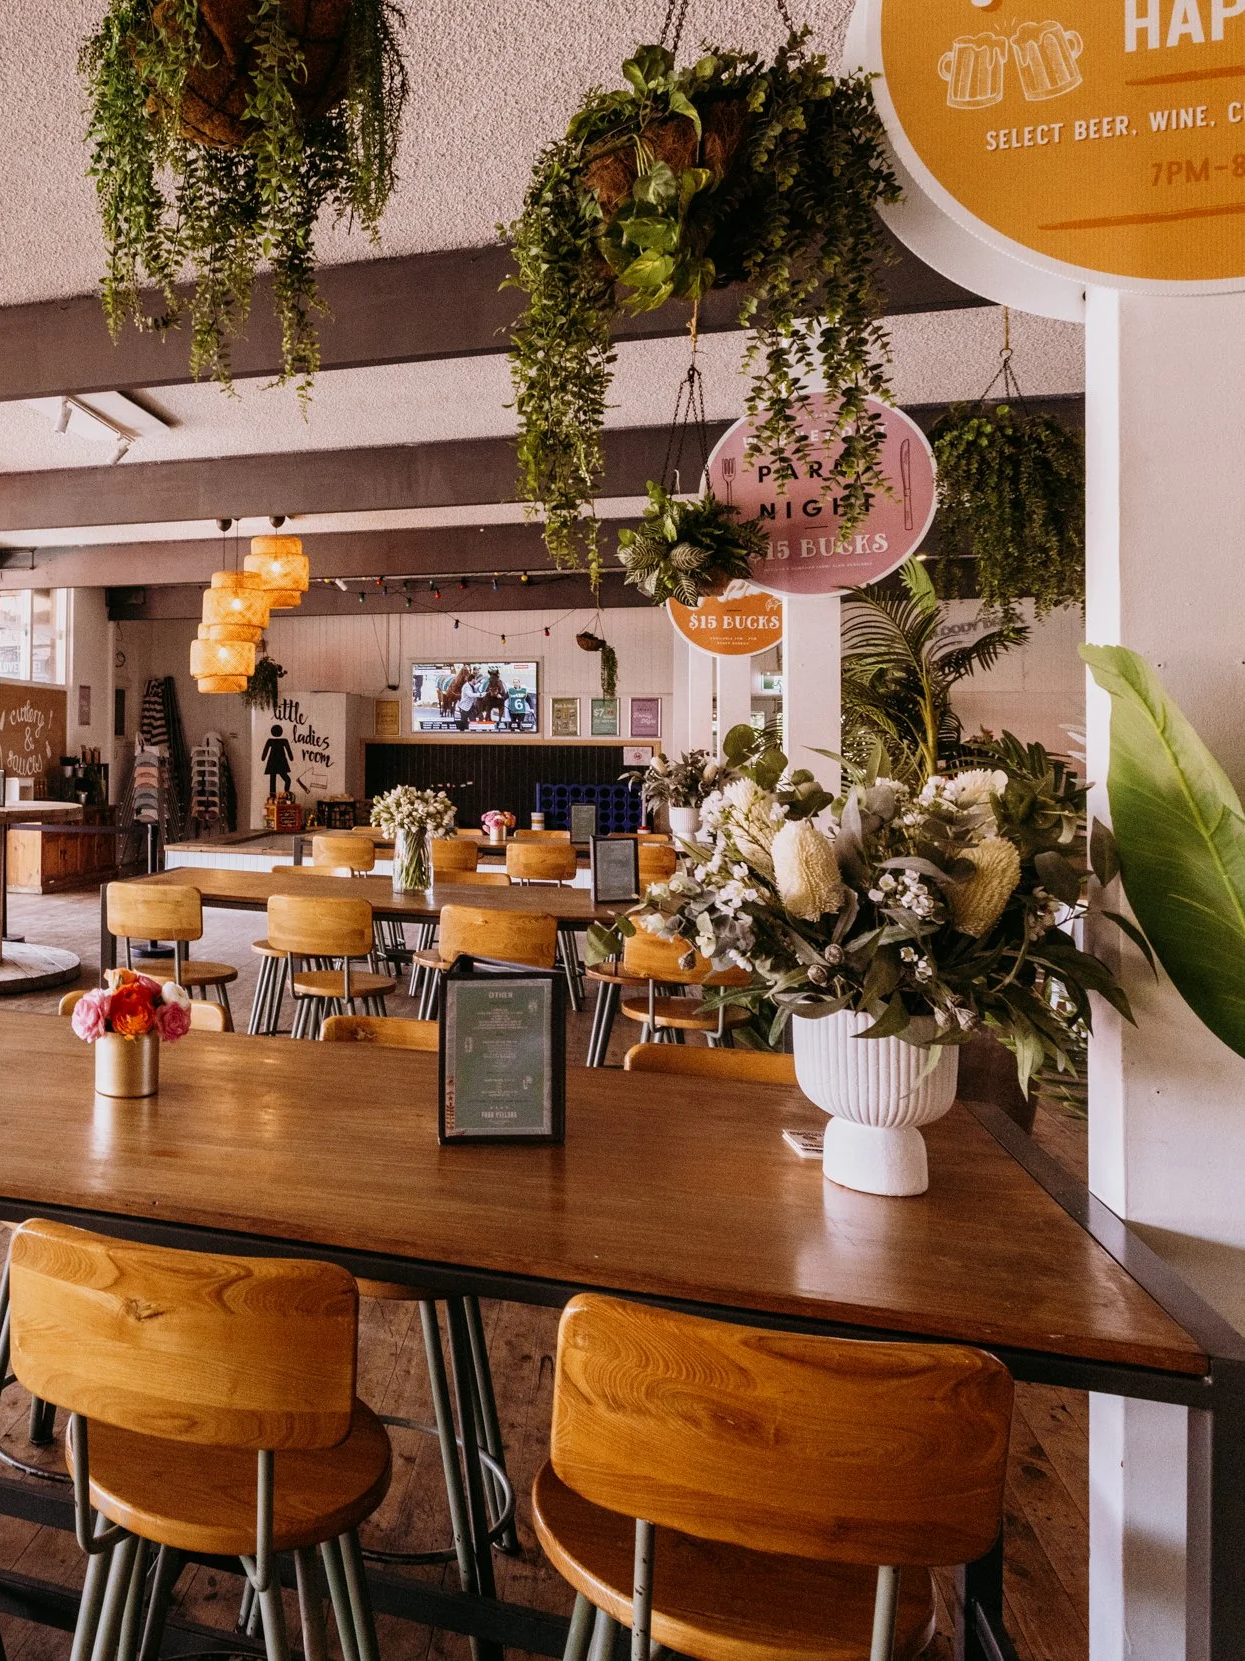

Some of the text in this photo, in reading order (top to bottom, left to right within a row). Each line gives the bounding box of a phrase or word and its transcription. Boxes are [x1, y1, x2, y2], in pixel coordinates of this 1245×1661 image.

[986, 101, 1245, 151] SELECT BEER, WINE, C
[749, 532, 889, 561] 15 BUCKS
[689, 613, 780, 631] $15 BUCKS
[271, 698, 308, 725] little
[515, 698, 524, 710] 6
[10, 699, 45, 739] cutlery
[24, 726, 34, 752] &
[292, 725, 330, 750] ladies
[7, 750, 43, 776] sauces
[302, 749, 334, 768] room
